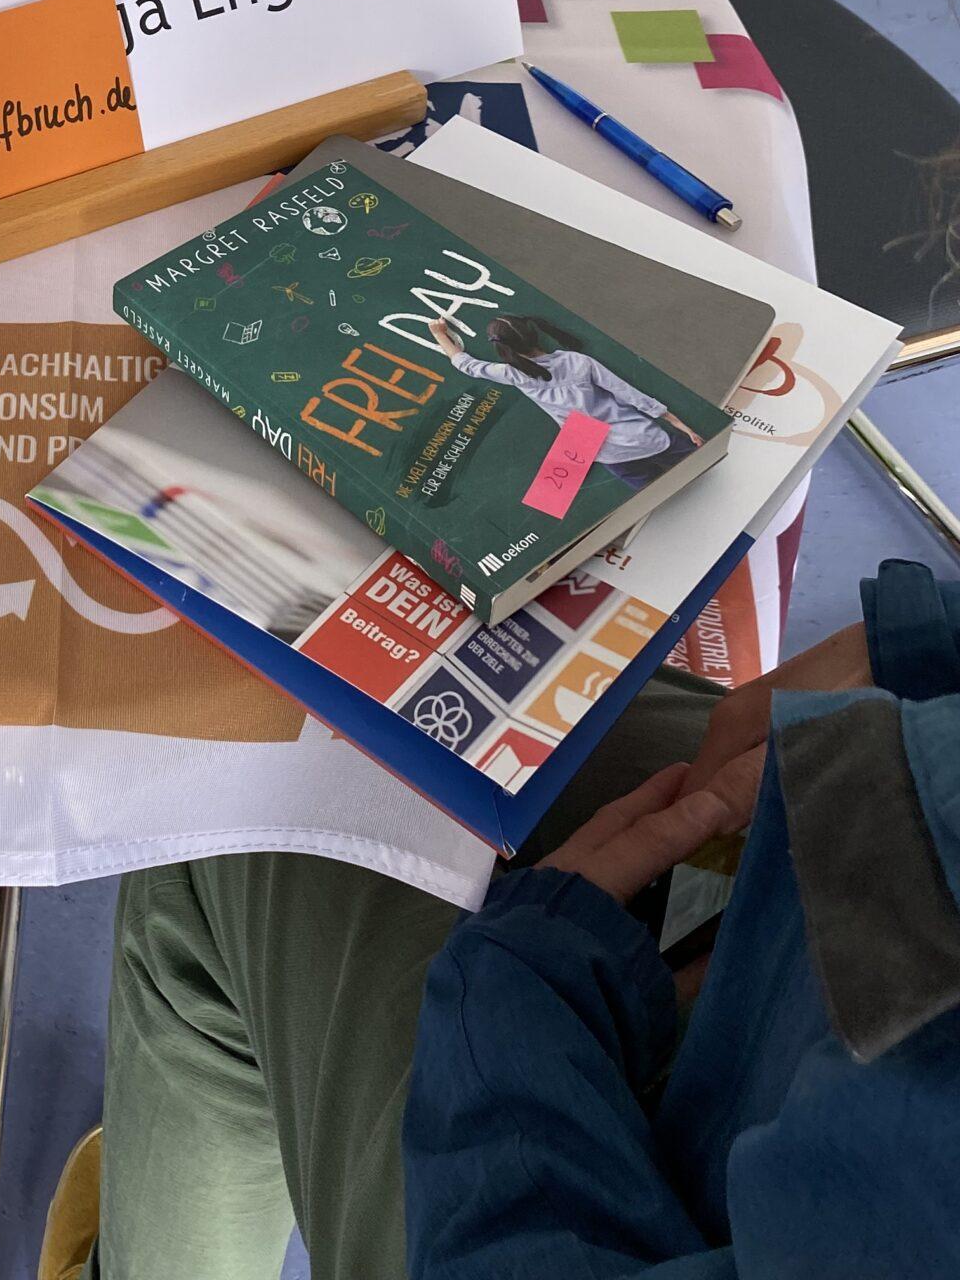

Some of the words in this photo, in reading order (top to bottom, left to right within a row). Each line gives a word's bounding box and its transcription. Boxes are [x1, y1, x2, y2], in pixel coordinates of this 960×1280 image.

[145, 229, 249, 294] MARGRET
[253, 176, 346, 234] RASFELD
[123, 305, 171, 353] RASFELD
[300, 342, 446, 457] FREI
[378, 249, 516, 357] DAY
[176, 350, 231, 403] MARGRET
[462, 423, 479, 436] IM
[470, 388, 503, 427] AUFBRUCH
[722, 404, 778, 437] spolitik
[251, 408, 293, 461] DAY
[443, 433, 472, 463] SCHULE
[296, 441, 338, 497] FREI
[395, 483, 414, 499] DIE
[405, 461, 429, 485] WELT
[419, 419, 458, 463] VERÄNDERN
[432, 460, 453, 480] EINE
[543, 467, 569, 490] 20
[421, 477, 442, 497] FÜR
[501, 531, 540, 564] oekom
[365, 576, 455, 641] DEIN
[388, 563, 430, 599] Was
[433, 591, 467, 619] ist
[339, 607, 421, 664] Beitrag?
[467, 639, 485, 658] DER
[481, 652, 506, 675] ZIELE
